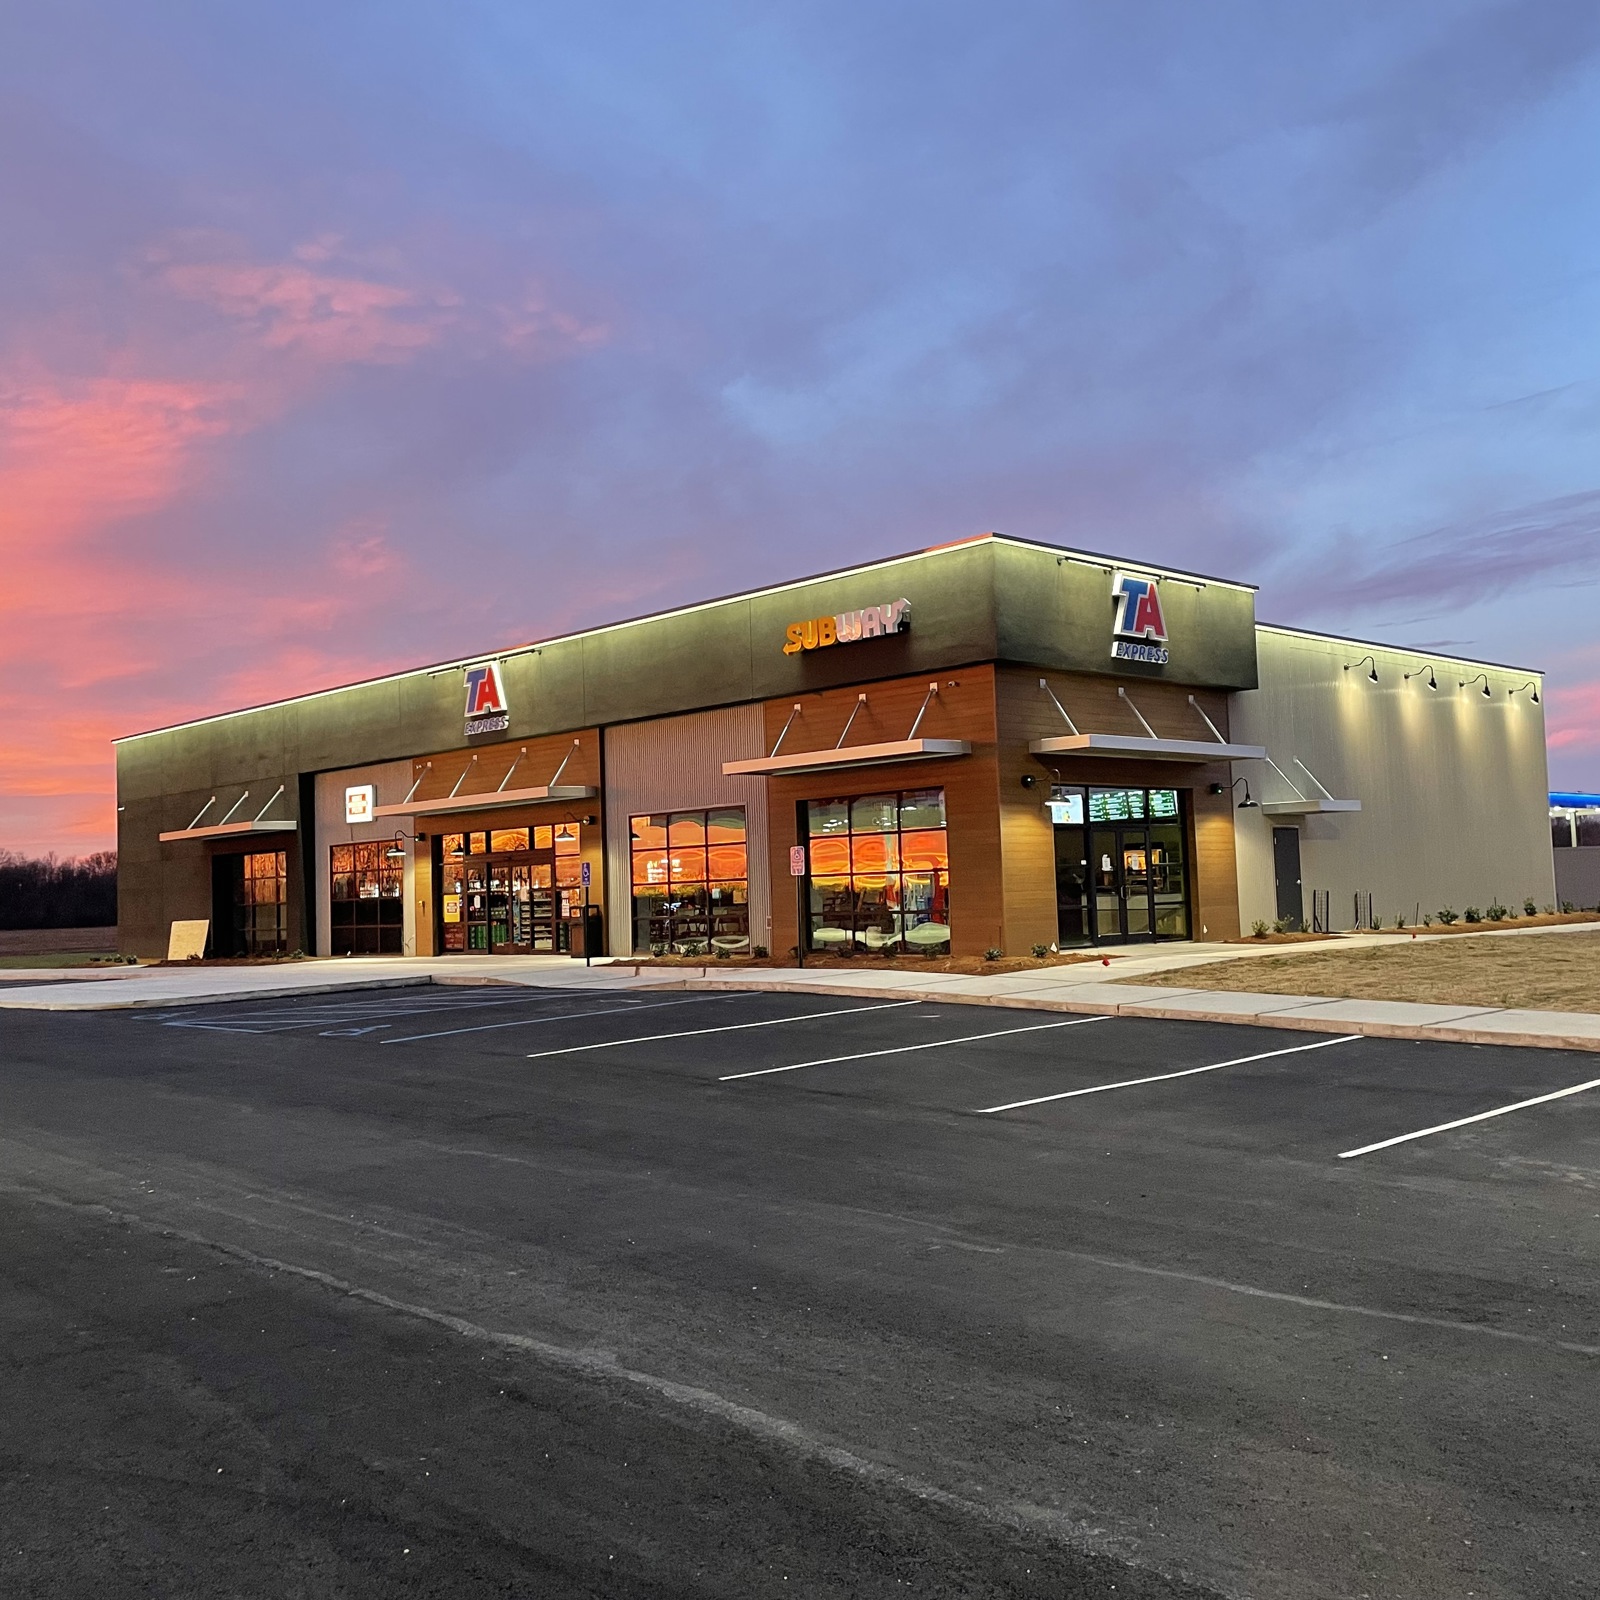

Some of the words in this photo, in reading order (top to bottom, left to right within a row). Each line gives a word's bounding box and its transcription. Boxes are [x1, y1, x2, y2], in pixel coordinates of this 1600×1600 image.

[782, 598, 908, 656] SUBWAY
[1118, 575, 1167, 639] TA
[1115, 642, 1169, 663] EXPRESS
[464, 665, 502, 716] TA
[464, 716, 509, 735] EXPRESS
